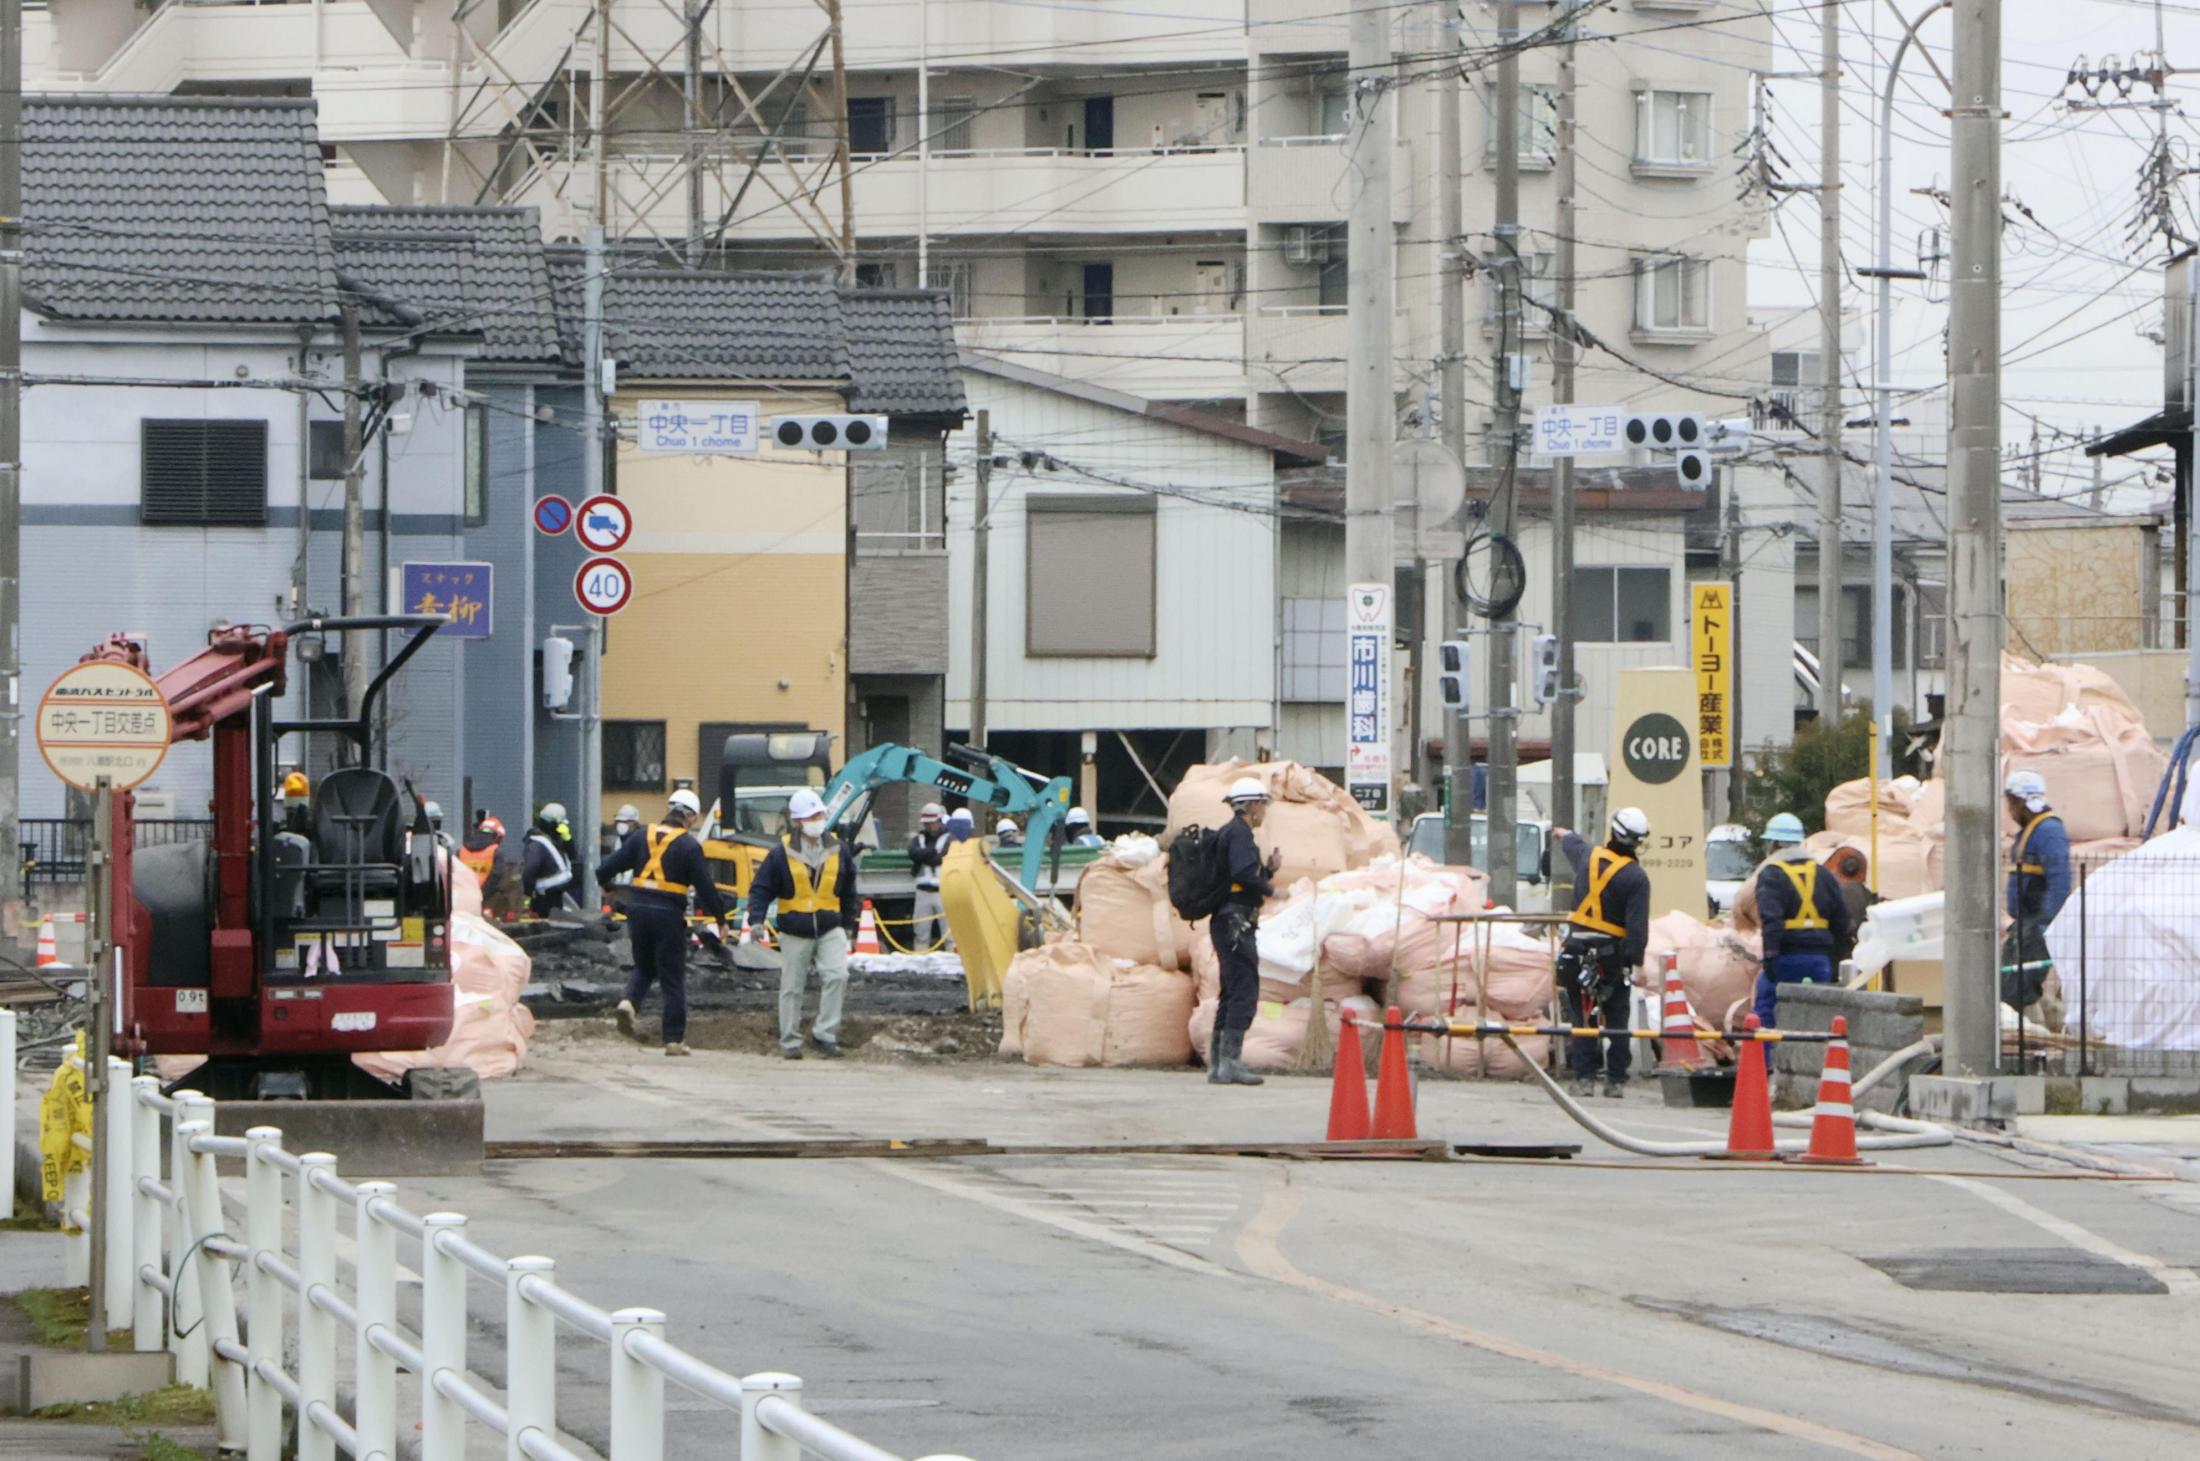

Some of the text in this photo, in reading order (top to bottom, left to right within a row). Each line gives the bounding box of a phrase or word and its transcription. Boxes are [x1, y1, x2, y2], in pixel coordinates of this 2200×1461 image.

[648, 413, 748, 435] 中央一丁目
[1541, 416, 1617, 438] 中央一丁目
[656, 435, 687, 446] Chuo
[701, 436, 742, 446] chome
[589, 573, 619, 598] 40
[1700, 615, 1723, 735] トーヨー産業
[1353, 637, 1377, 742] 市川歯科
[51, 710, 157, 735] 中央一丁目交差点
[1629, 736, 1683, 761] CORE
